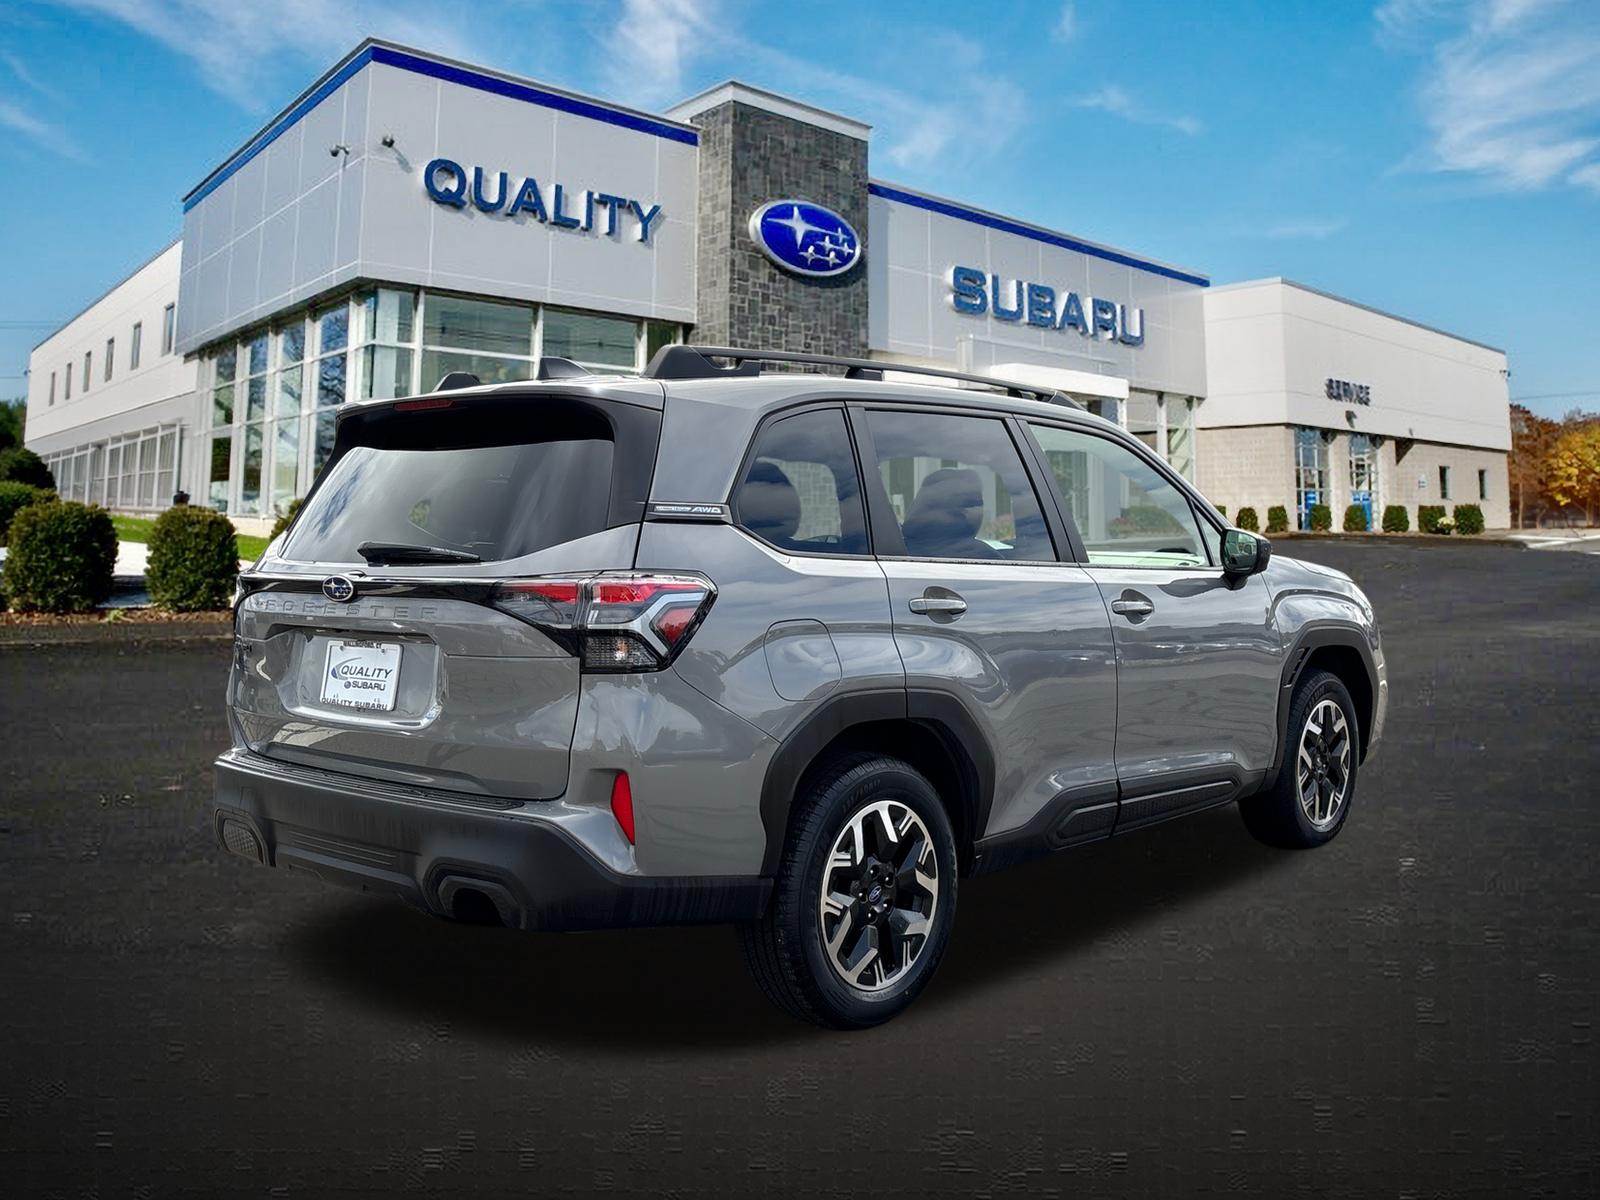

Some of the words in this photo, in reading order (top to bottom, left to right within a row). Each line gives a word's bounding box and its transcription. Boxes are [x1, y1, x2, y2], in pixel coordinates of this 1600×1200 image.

[423, 158, 662, 243] QUALITY
[950, 265, 1145, 347] SUBARU
[1324, 378, 1371, 406] SERVICE
[691, 506, 722, 514] AWD
[340, 665, 393, 679] QUALITY
[351, 681, 386, 692] SUBARU
[321, 697, 353, 707] QUALITY
[354, 700, 388, 711] SUBARU
